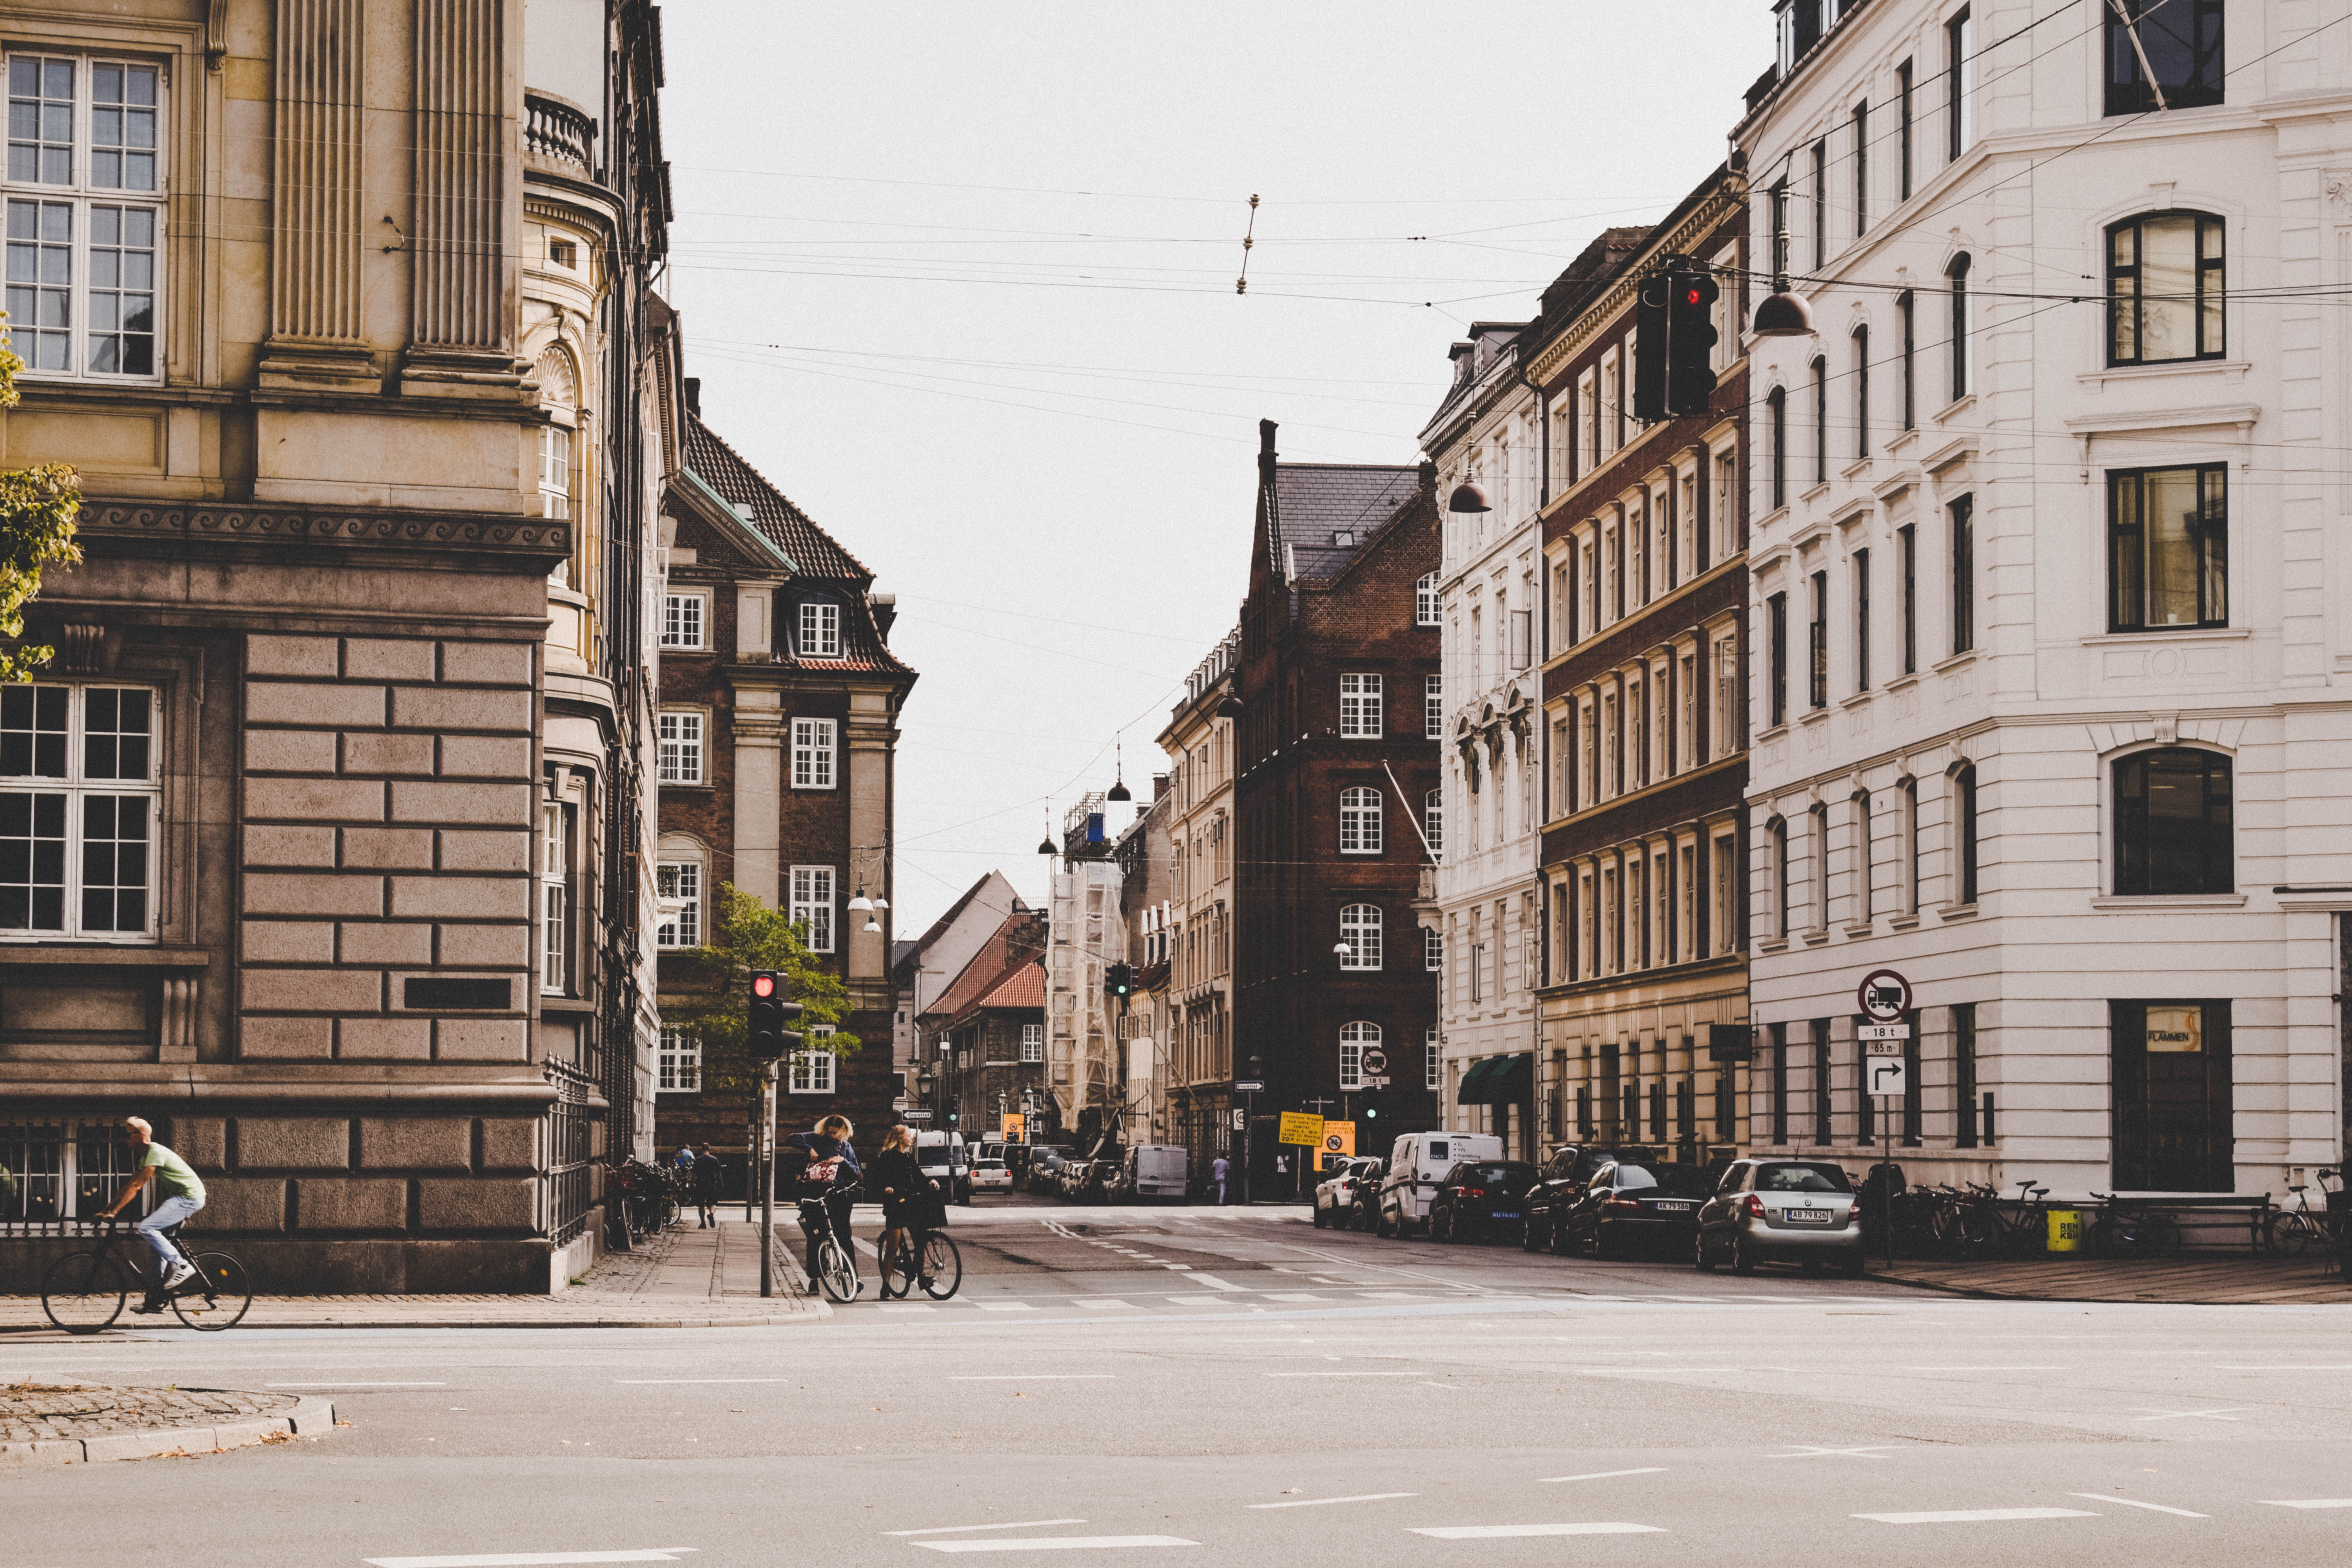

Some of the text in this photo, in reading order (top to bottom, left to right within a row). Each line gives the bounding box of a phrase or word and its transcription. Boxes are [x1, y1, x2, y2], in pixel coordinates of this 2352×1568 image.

[1873, 1027, 1895, 1037] 18 t
[2148, 1033, 2189, 1042] FLAMMEN
[1875, 1043, 1884, 1052] 65
